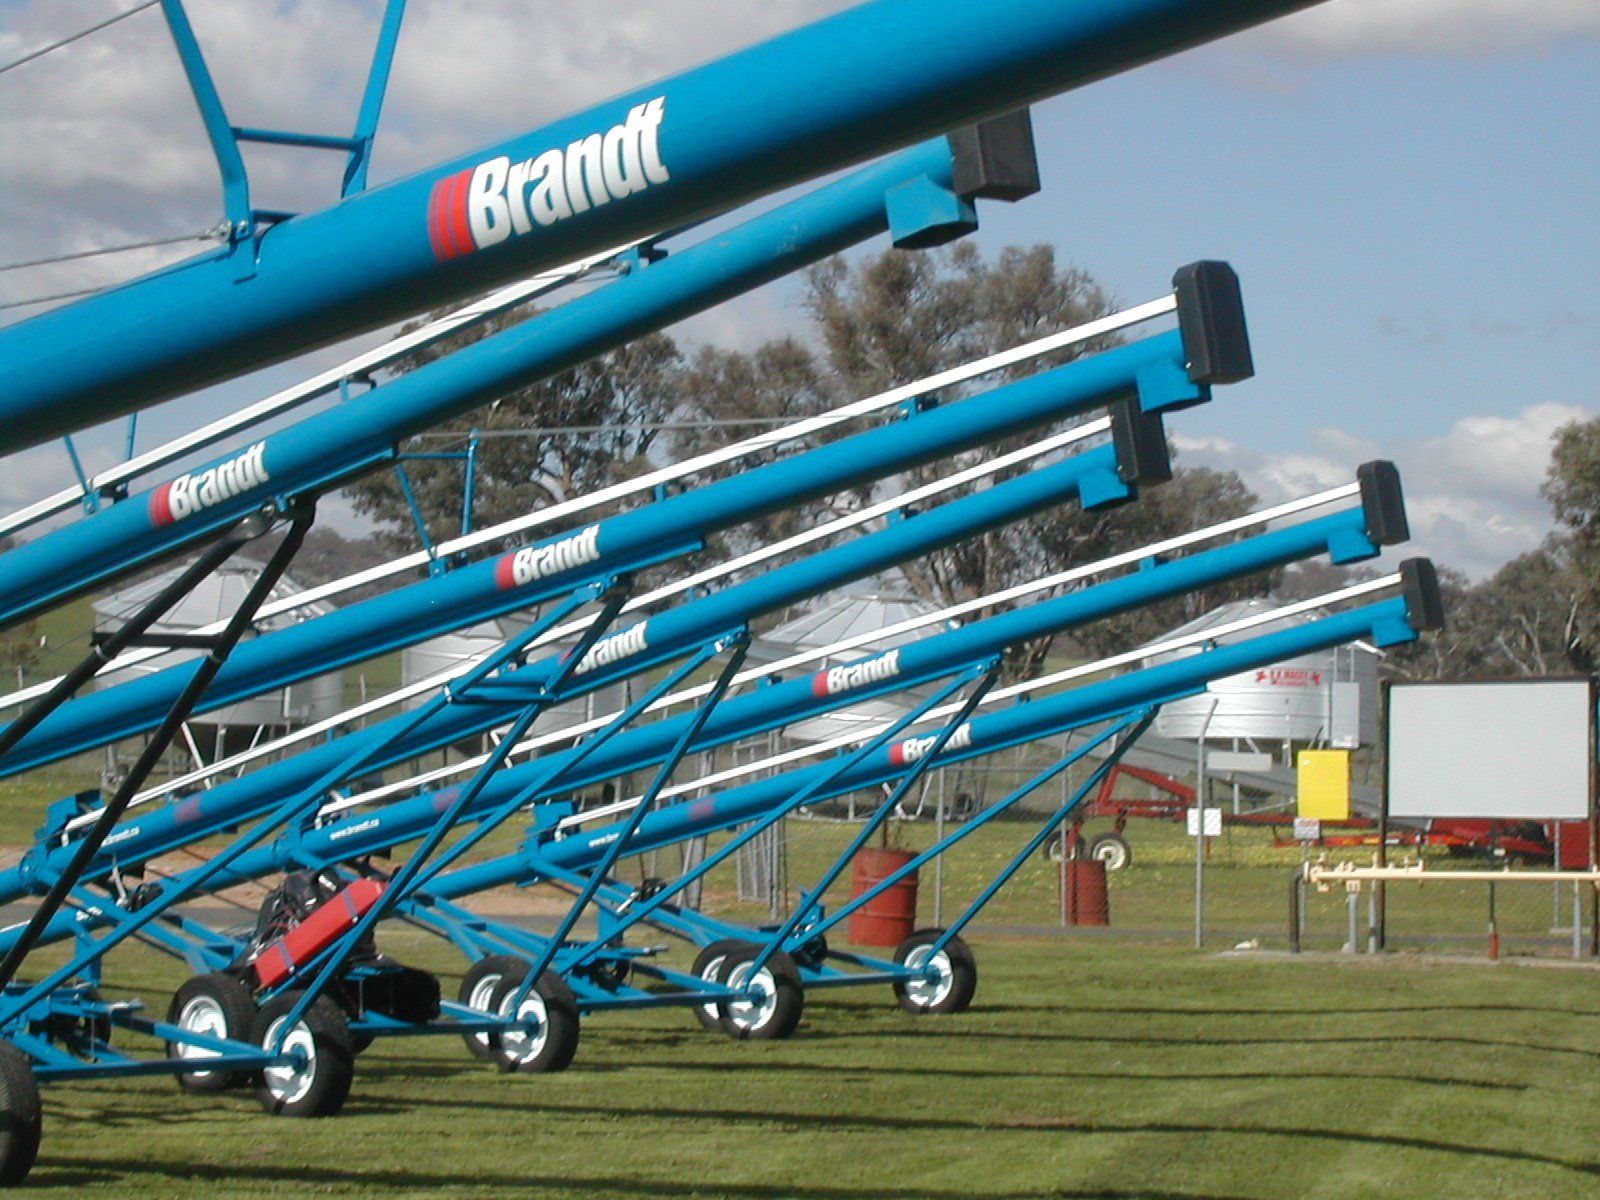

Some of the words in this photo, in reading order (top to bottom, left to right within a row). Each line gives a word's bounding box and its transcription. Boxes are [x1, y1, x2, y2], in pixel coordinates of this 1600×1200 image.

[469, 96, 670, 250] Brandt
[168, 440, 270, 521] Brandt
[512, 523, 600, 586] Brandt
[827, 649, 900, 694] Brandt
